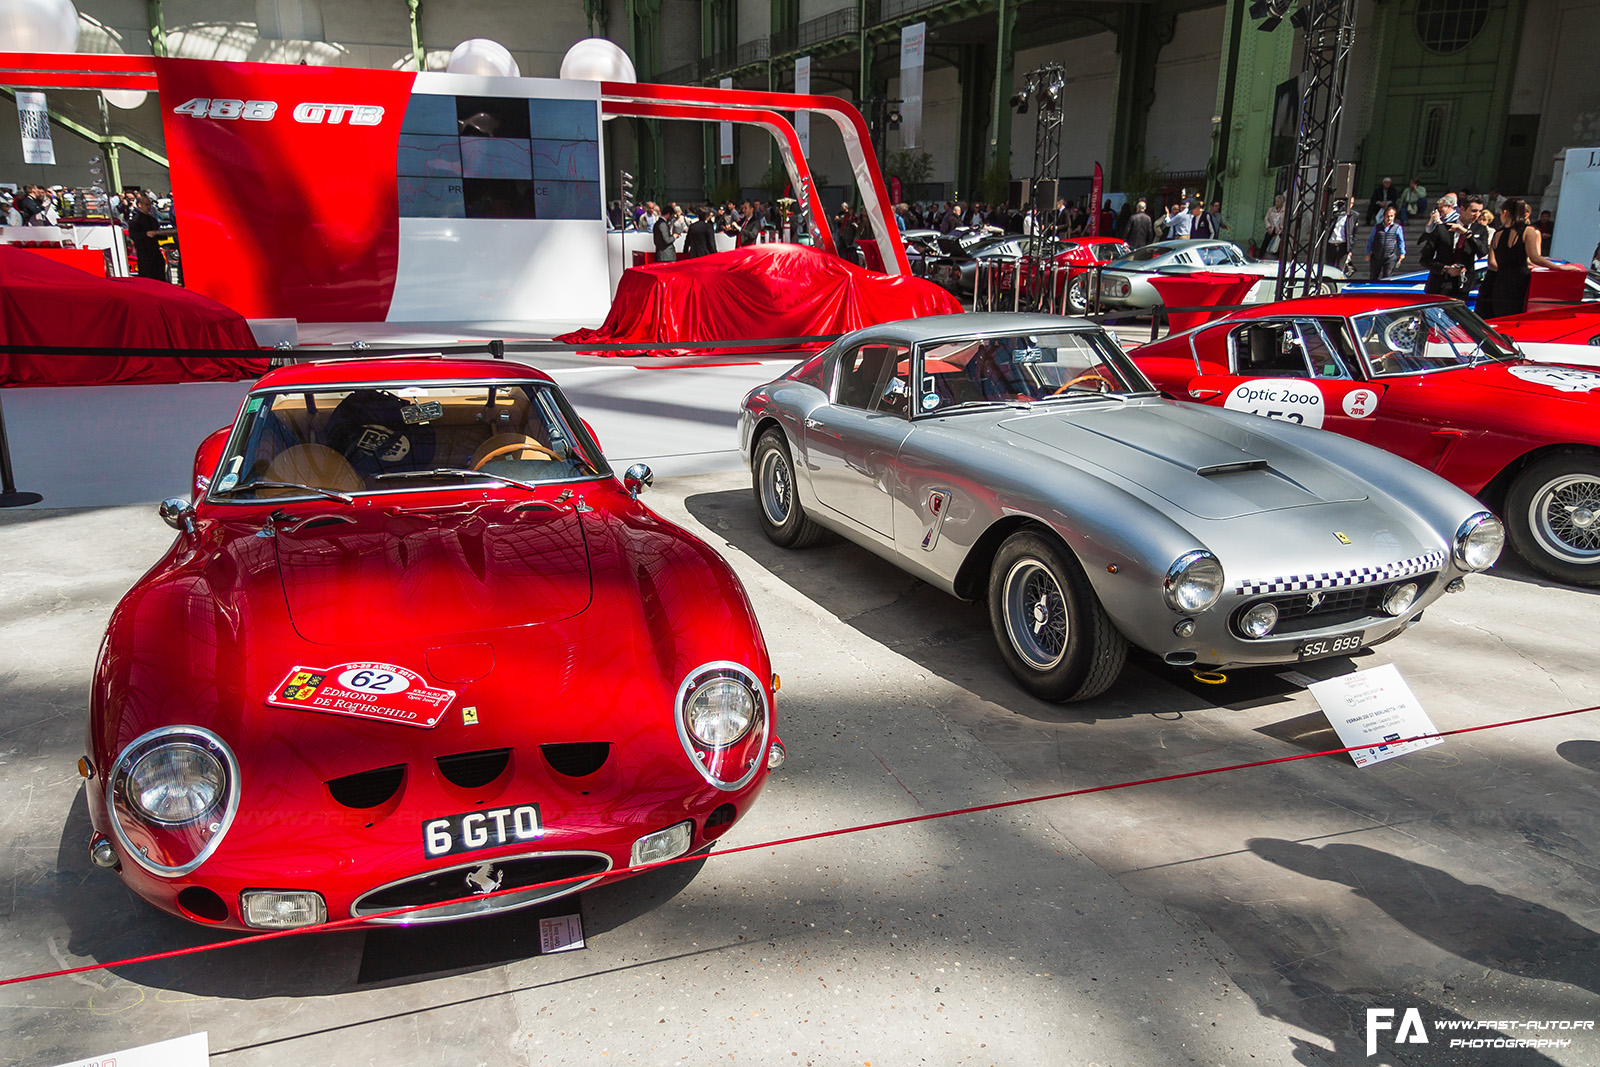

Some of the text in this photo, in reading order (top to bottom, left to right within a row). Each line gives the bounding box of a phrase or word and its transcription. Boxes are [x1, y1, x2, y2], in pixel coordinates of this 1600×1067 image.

[174, 98, 385, 126] 488 GTB
[1237, 387, 1319, 405] Optic 2000
[1350, 407, 1365, 416] 2015
[1303, 636, 1360, 657] SSL 899
[351, 670, 394, 691] 62
[320, 687, 378, 703] EDMOND
[313, 697, 418, 720] DE ROTHSCHILD
[427, 819, 452, 855] 6
[462, 806, 539, 848] GTO
